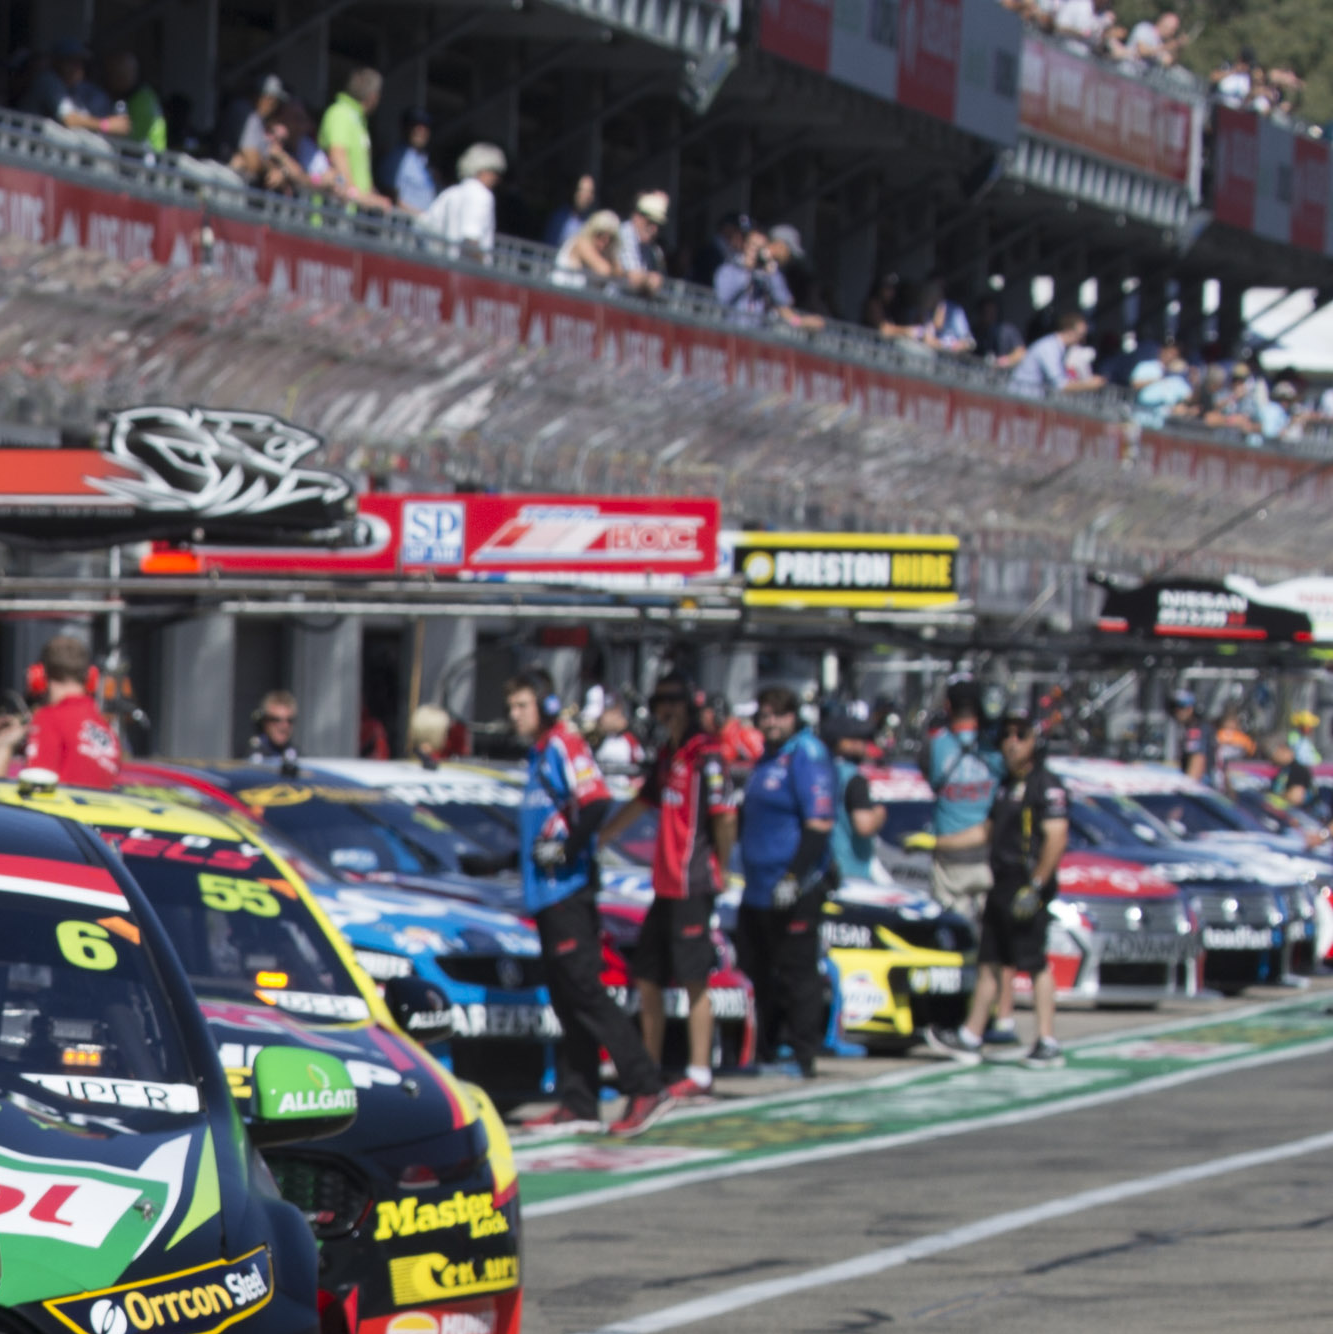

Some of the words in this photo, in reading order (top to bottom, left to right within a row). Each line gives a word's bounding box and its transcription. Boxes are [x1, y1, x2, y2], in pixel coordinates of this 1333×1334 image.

[774, 551, 890, 587] PRESTON
[891, 552, 953, 588] HIRE
[197, 872, 282, 918] 55
[56, 920, 118, 971] 6
[374, 1190, 494, 1242] Master
[469, 1210, 509, 1240] Lock
[123, 1282, 234, 1331] Orrcon
[224, 1263, 268, 1307] Steel
